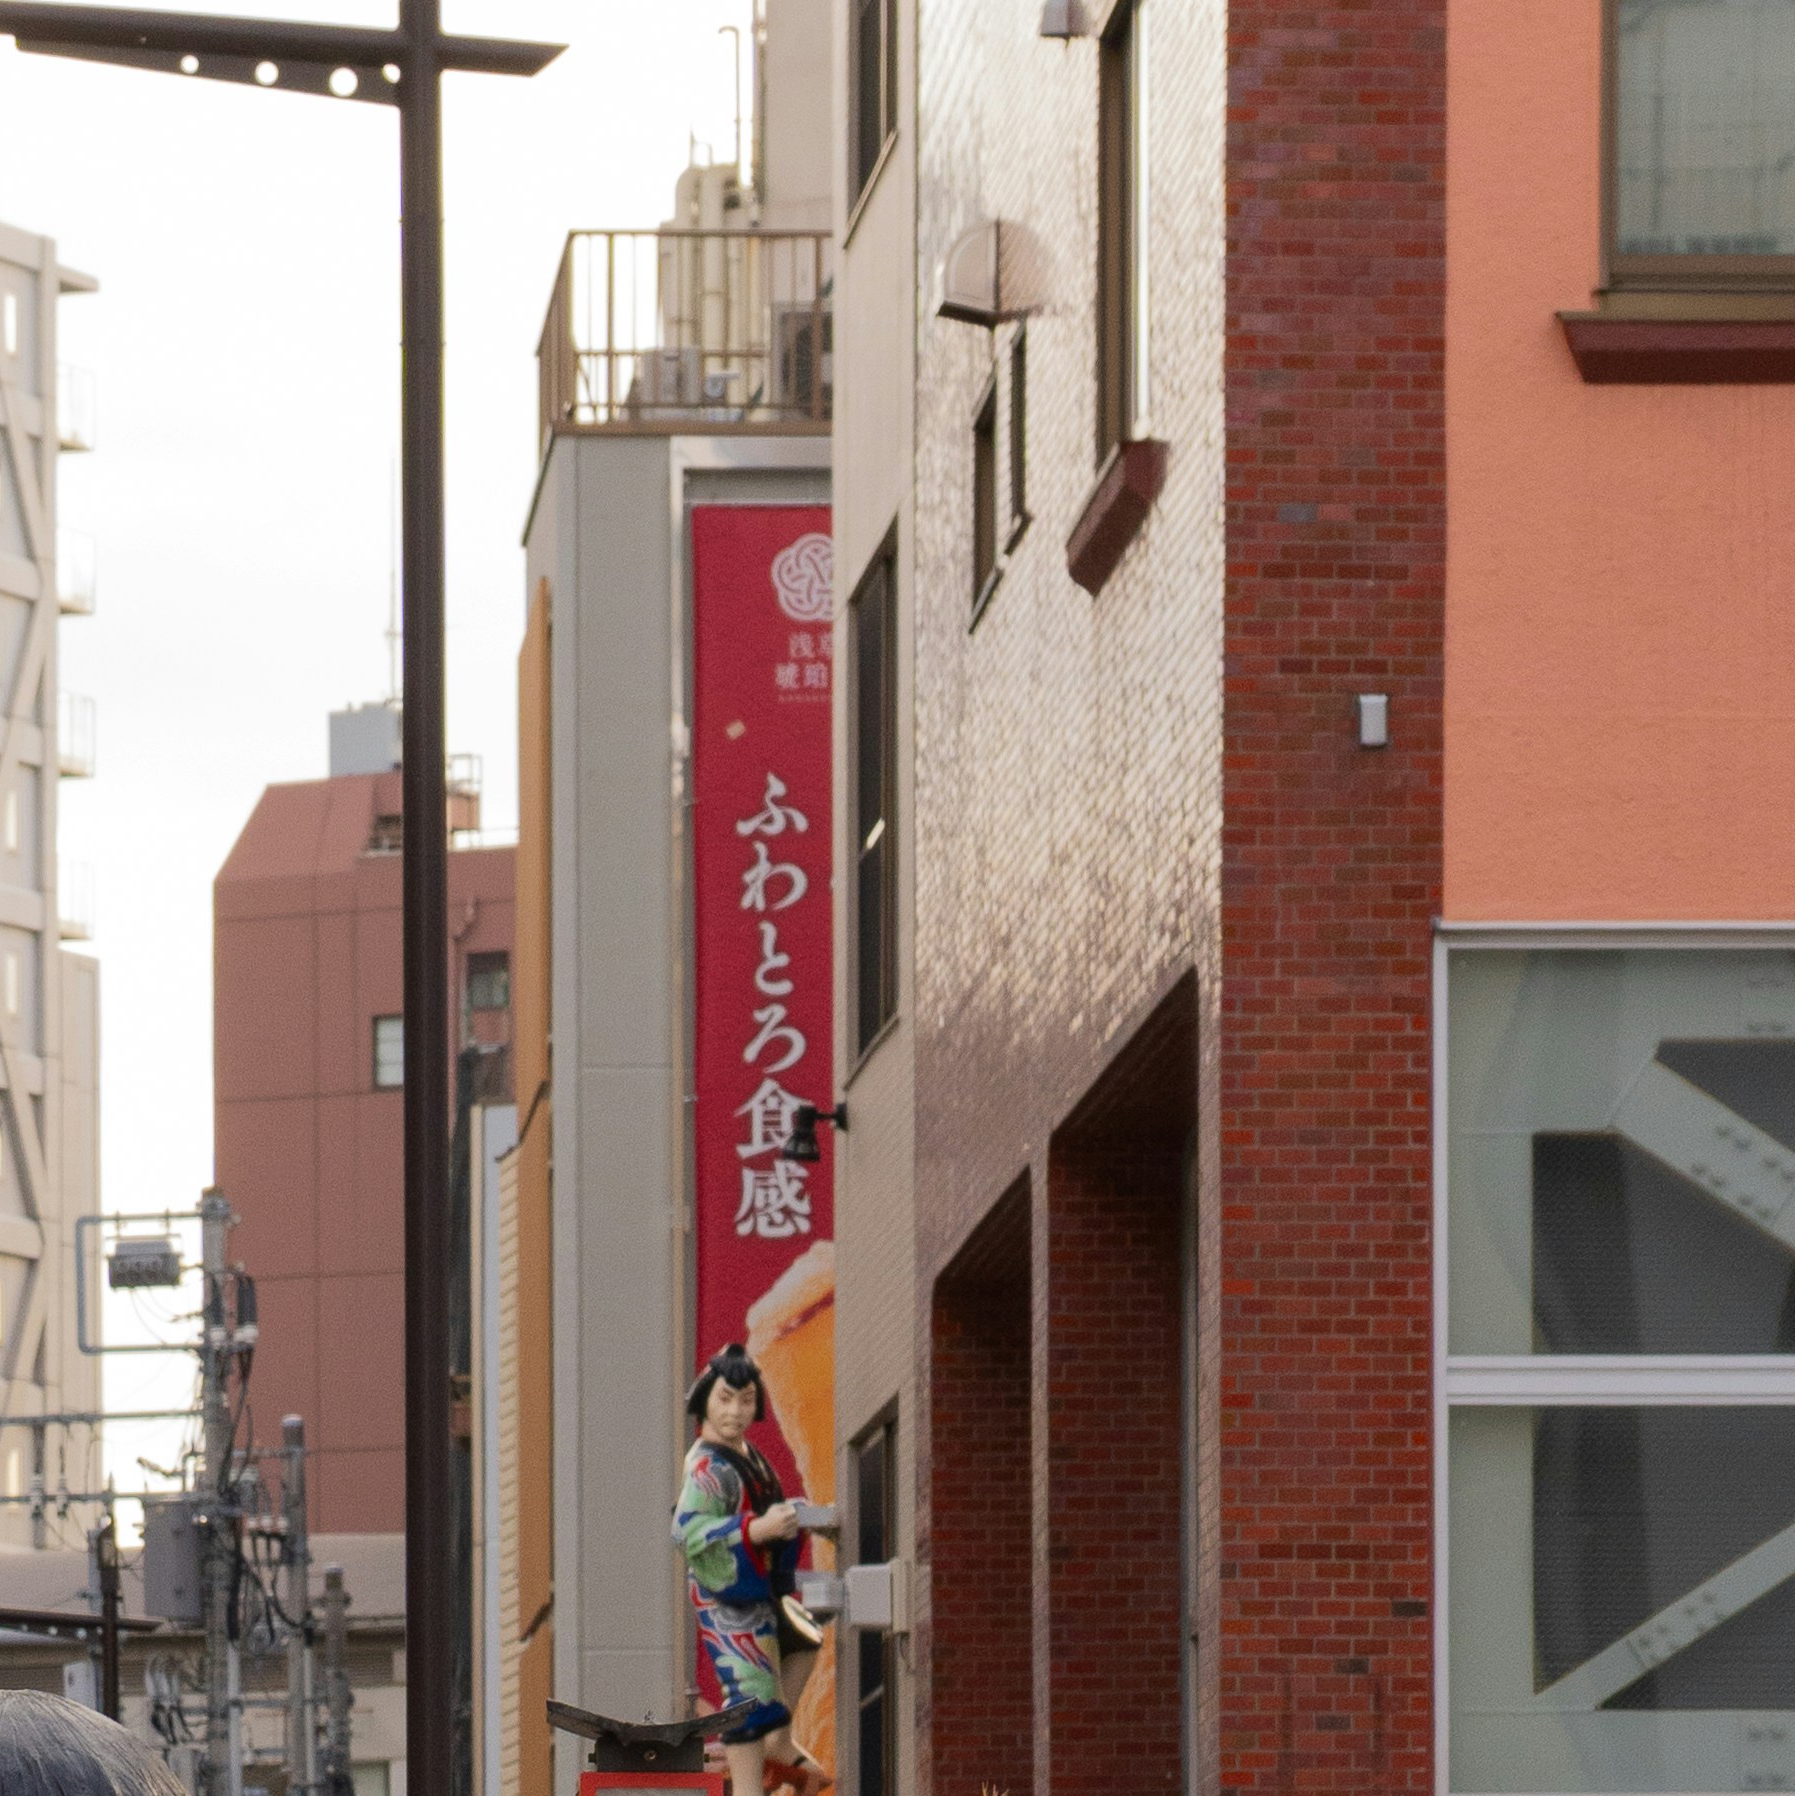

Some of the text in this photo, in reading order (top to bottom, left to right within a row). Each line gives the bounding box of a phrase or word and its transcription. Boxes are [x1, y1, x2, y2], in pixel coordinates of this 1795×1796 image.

[733, 772, 814, 1239] ふわとろ食感
